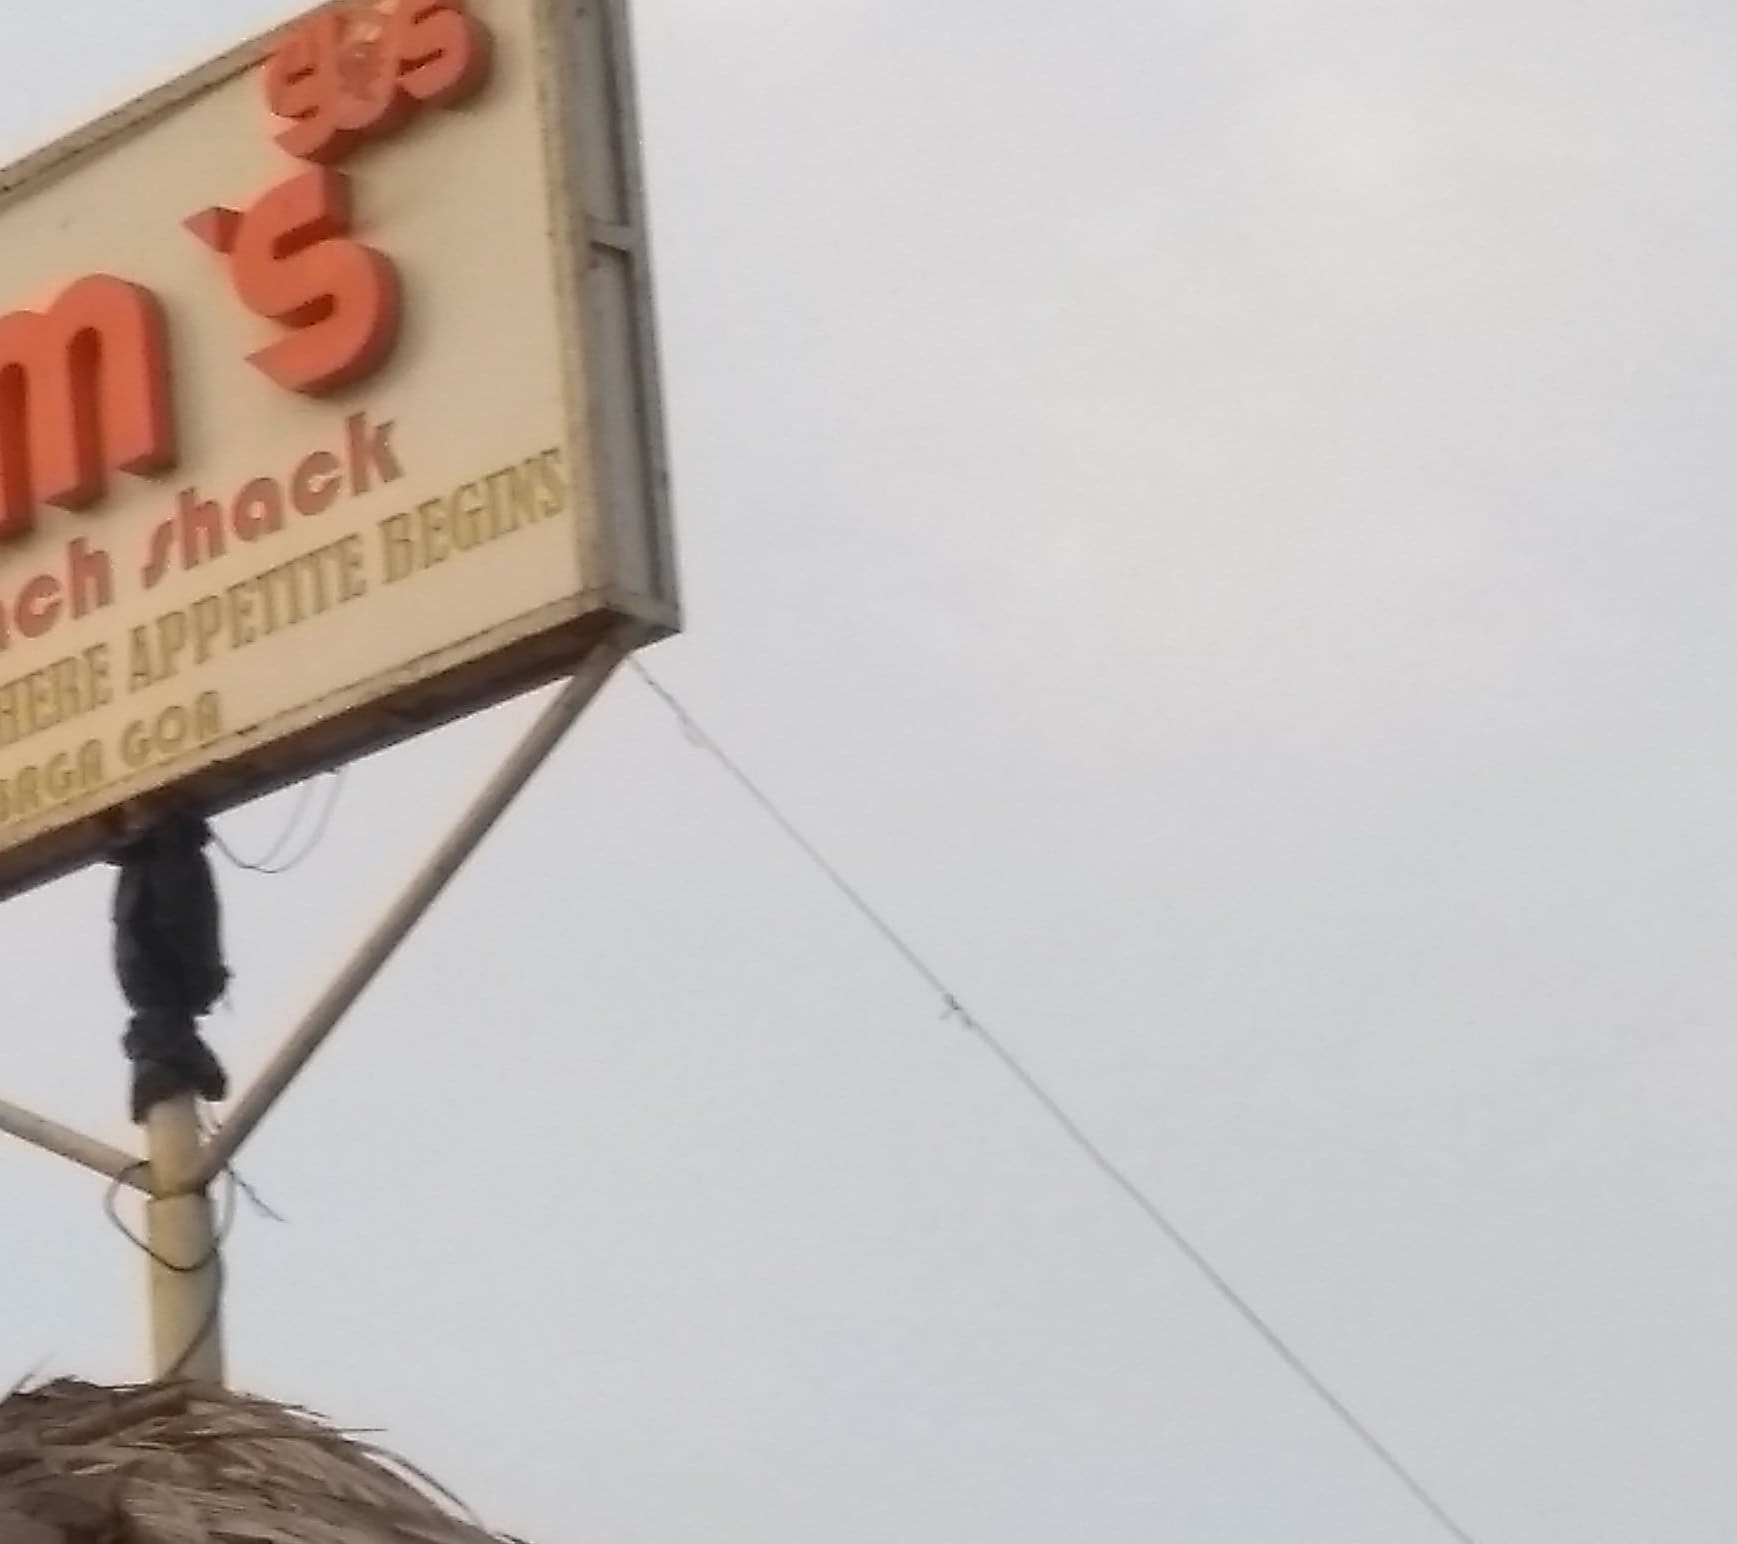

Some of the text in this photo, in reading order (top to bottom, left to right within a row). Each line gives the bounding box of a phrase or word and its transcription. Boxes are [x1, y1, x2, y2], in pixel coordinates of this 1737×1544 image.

[127, 532, 368, 694] APPETITE
[377, 448, 566, 584] BEGINS
[140, 410, 406, 590] shack
[120, 688, 222, 768] GOA
